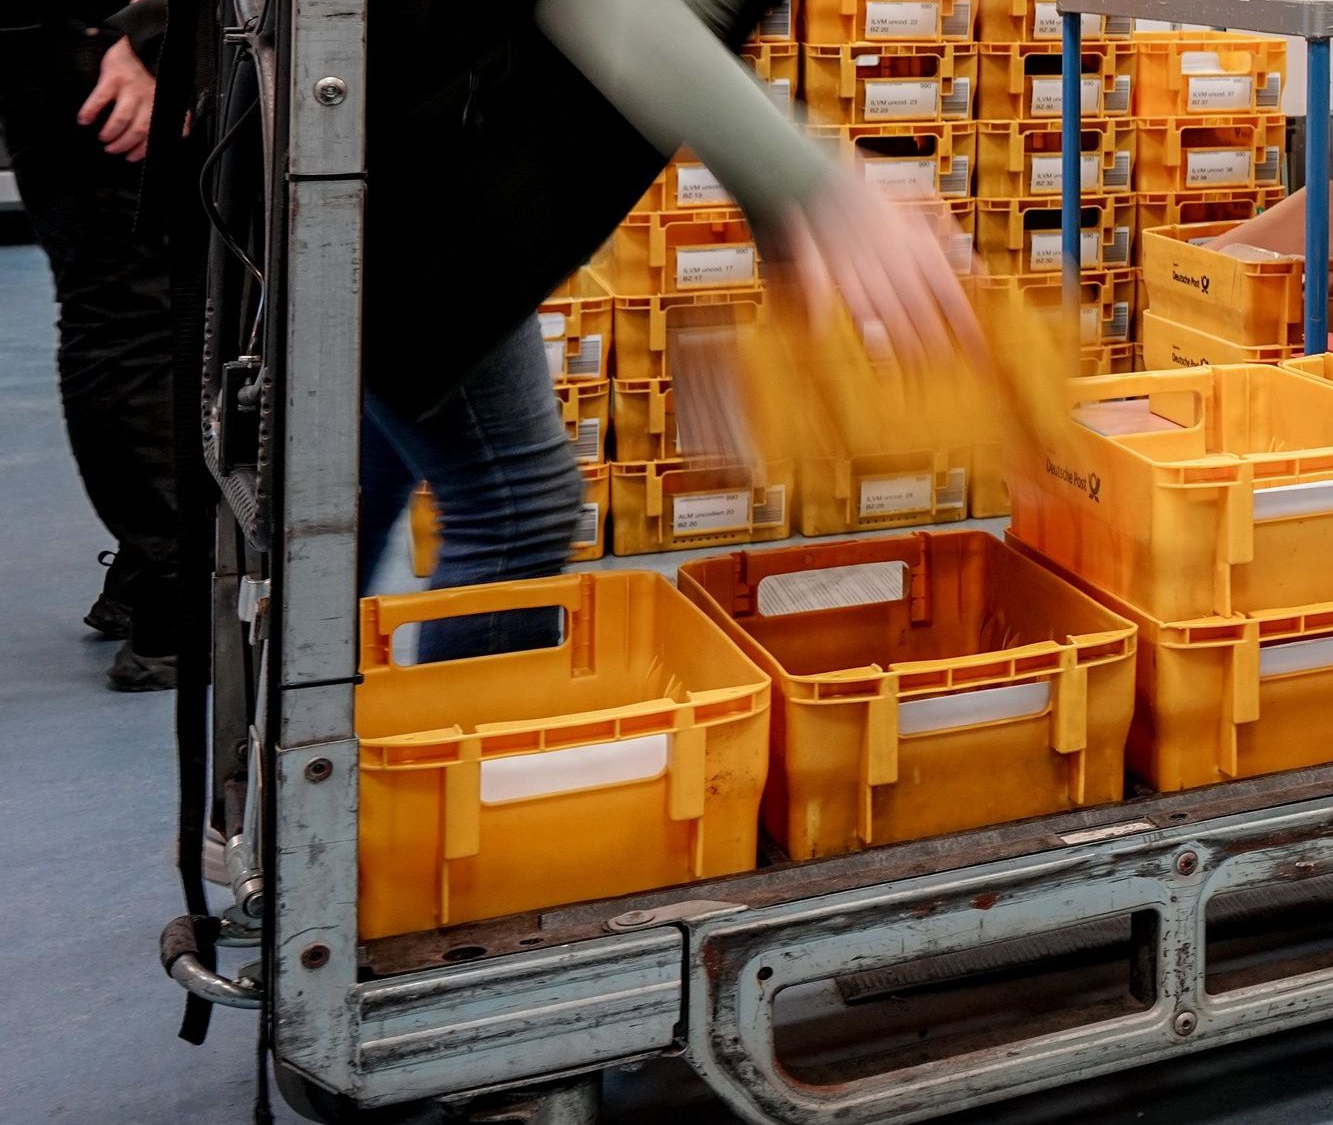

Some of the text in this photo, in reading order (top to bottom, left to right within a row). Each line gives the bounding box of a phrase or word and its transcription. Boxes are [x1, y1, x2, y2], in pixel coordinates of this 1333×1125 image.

[1172, 270, 1200, 288] Deutsche Post
[1046, 459, 1087, 492] Deutsche Post
